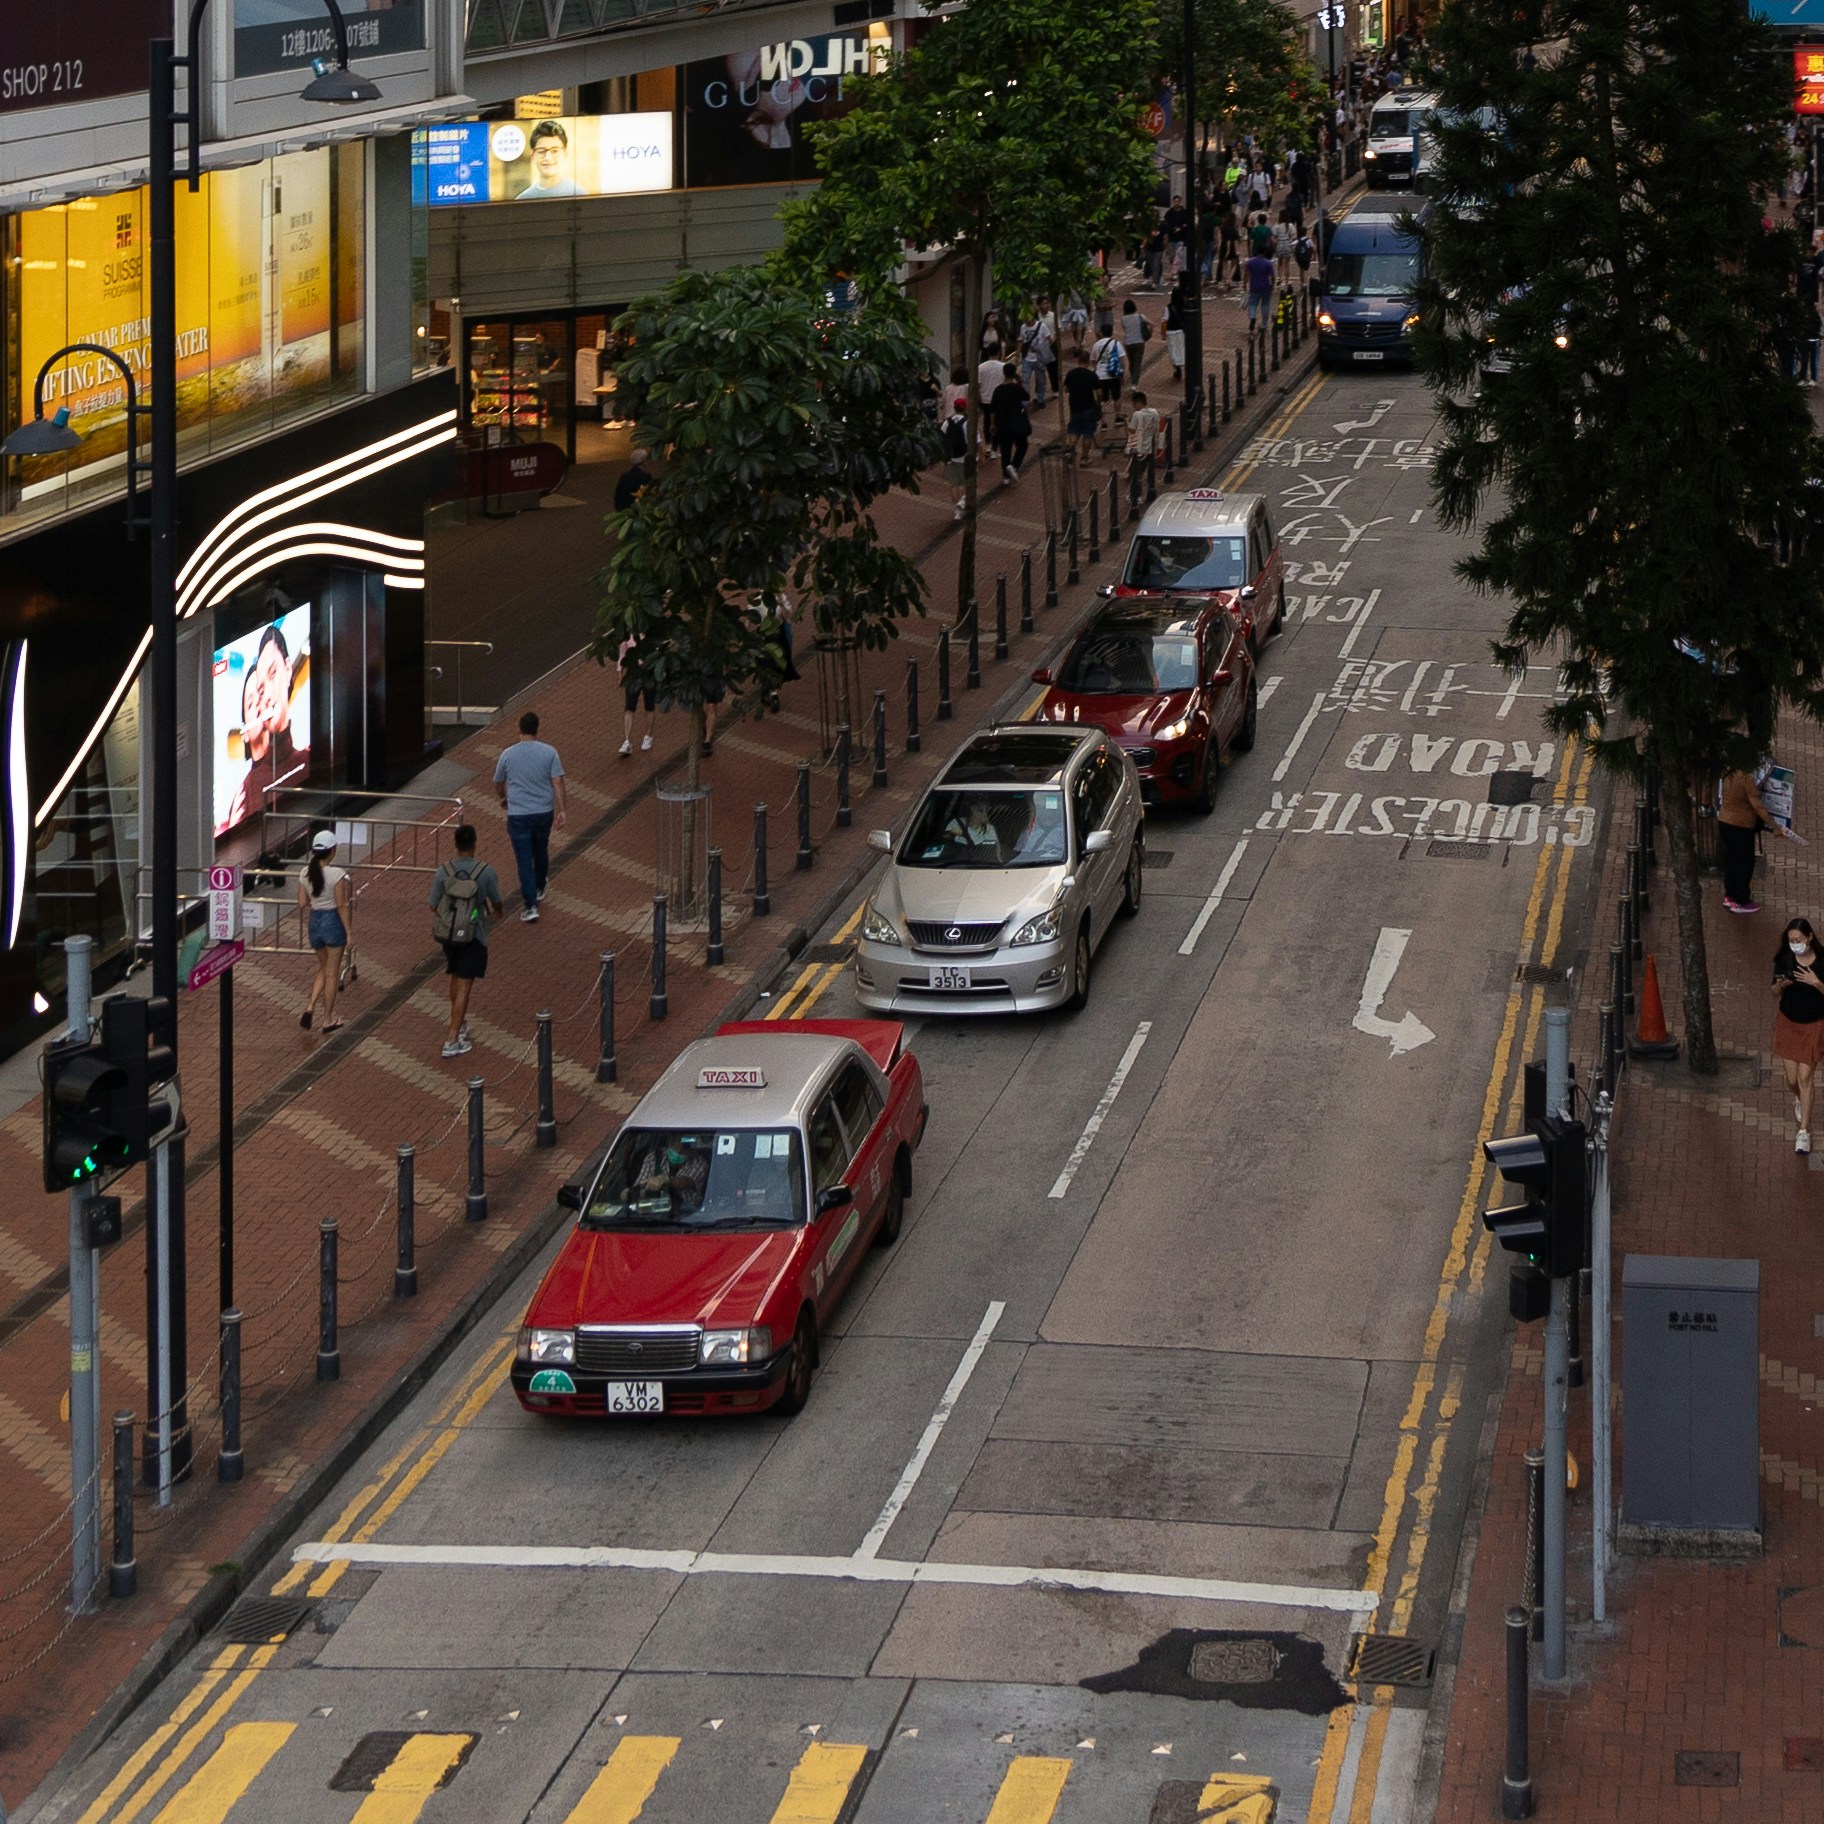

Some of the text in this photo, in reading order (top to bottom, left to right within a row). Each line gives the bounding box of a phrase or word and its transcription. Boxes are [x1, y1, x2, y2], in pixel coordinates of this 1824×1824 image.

[2, 60, 83, 99] SHOP 212
[1802, 93, 1818, 104] 24
[613, 145, 661, 160] HOYA
[437, 184, 476, 197] HOYA
[510, 457, 537, 471] MUJI
[1190, 489, 1217, 499] TAXI
[1344, 732, 1555, 778] ROAD
[940, 967, 959, 977] TC
[933, 977, 968, 990] 3513
[703, 1072, 758, 1084] TAXI
[547, 1377, 556, 1386] 4
[625, 1382, 647, 1397] VM
[613, 1396, 660, 1411] 6302
